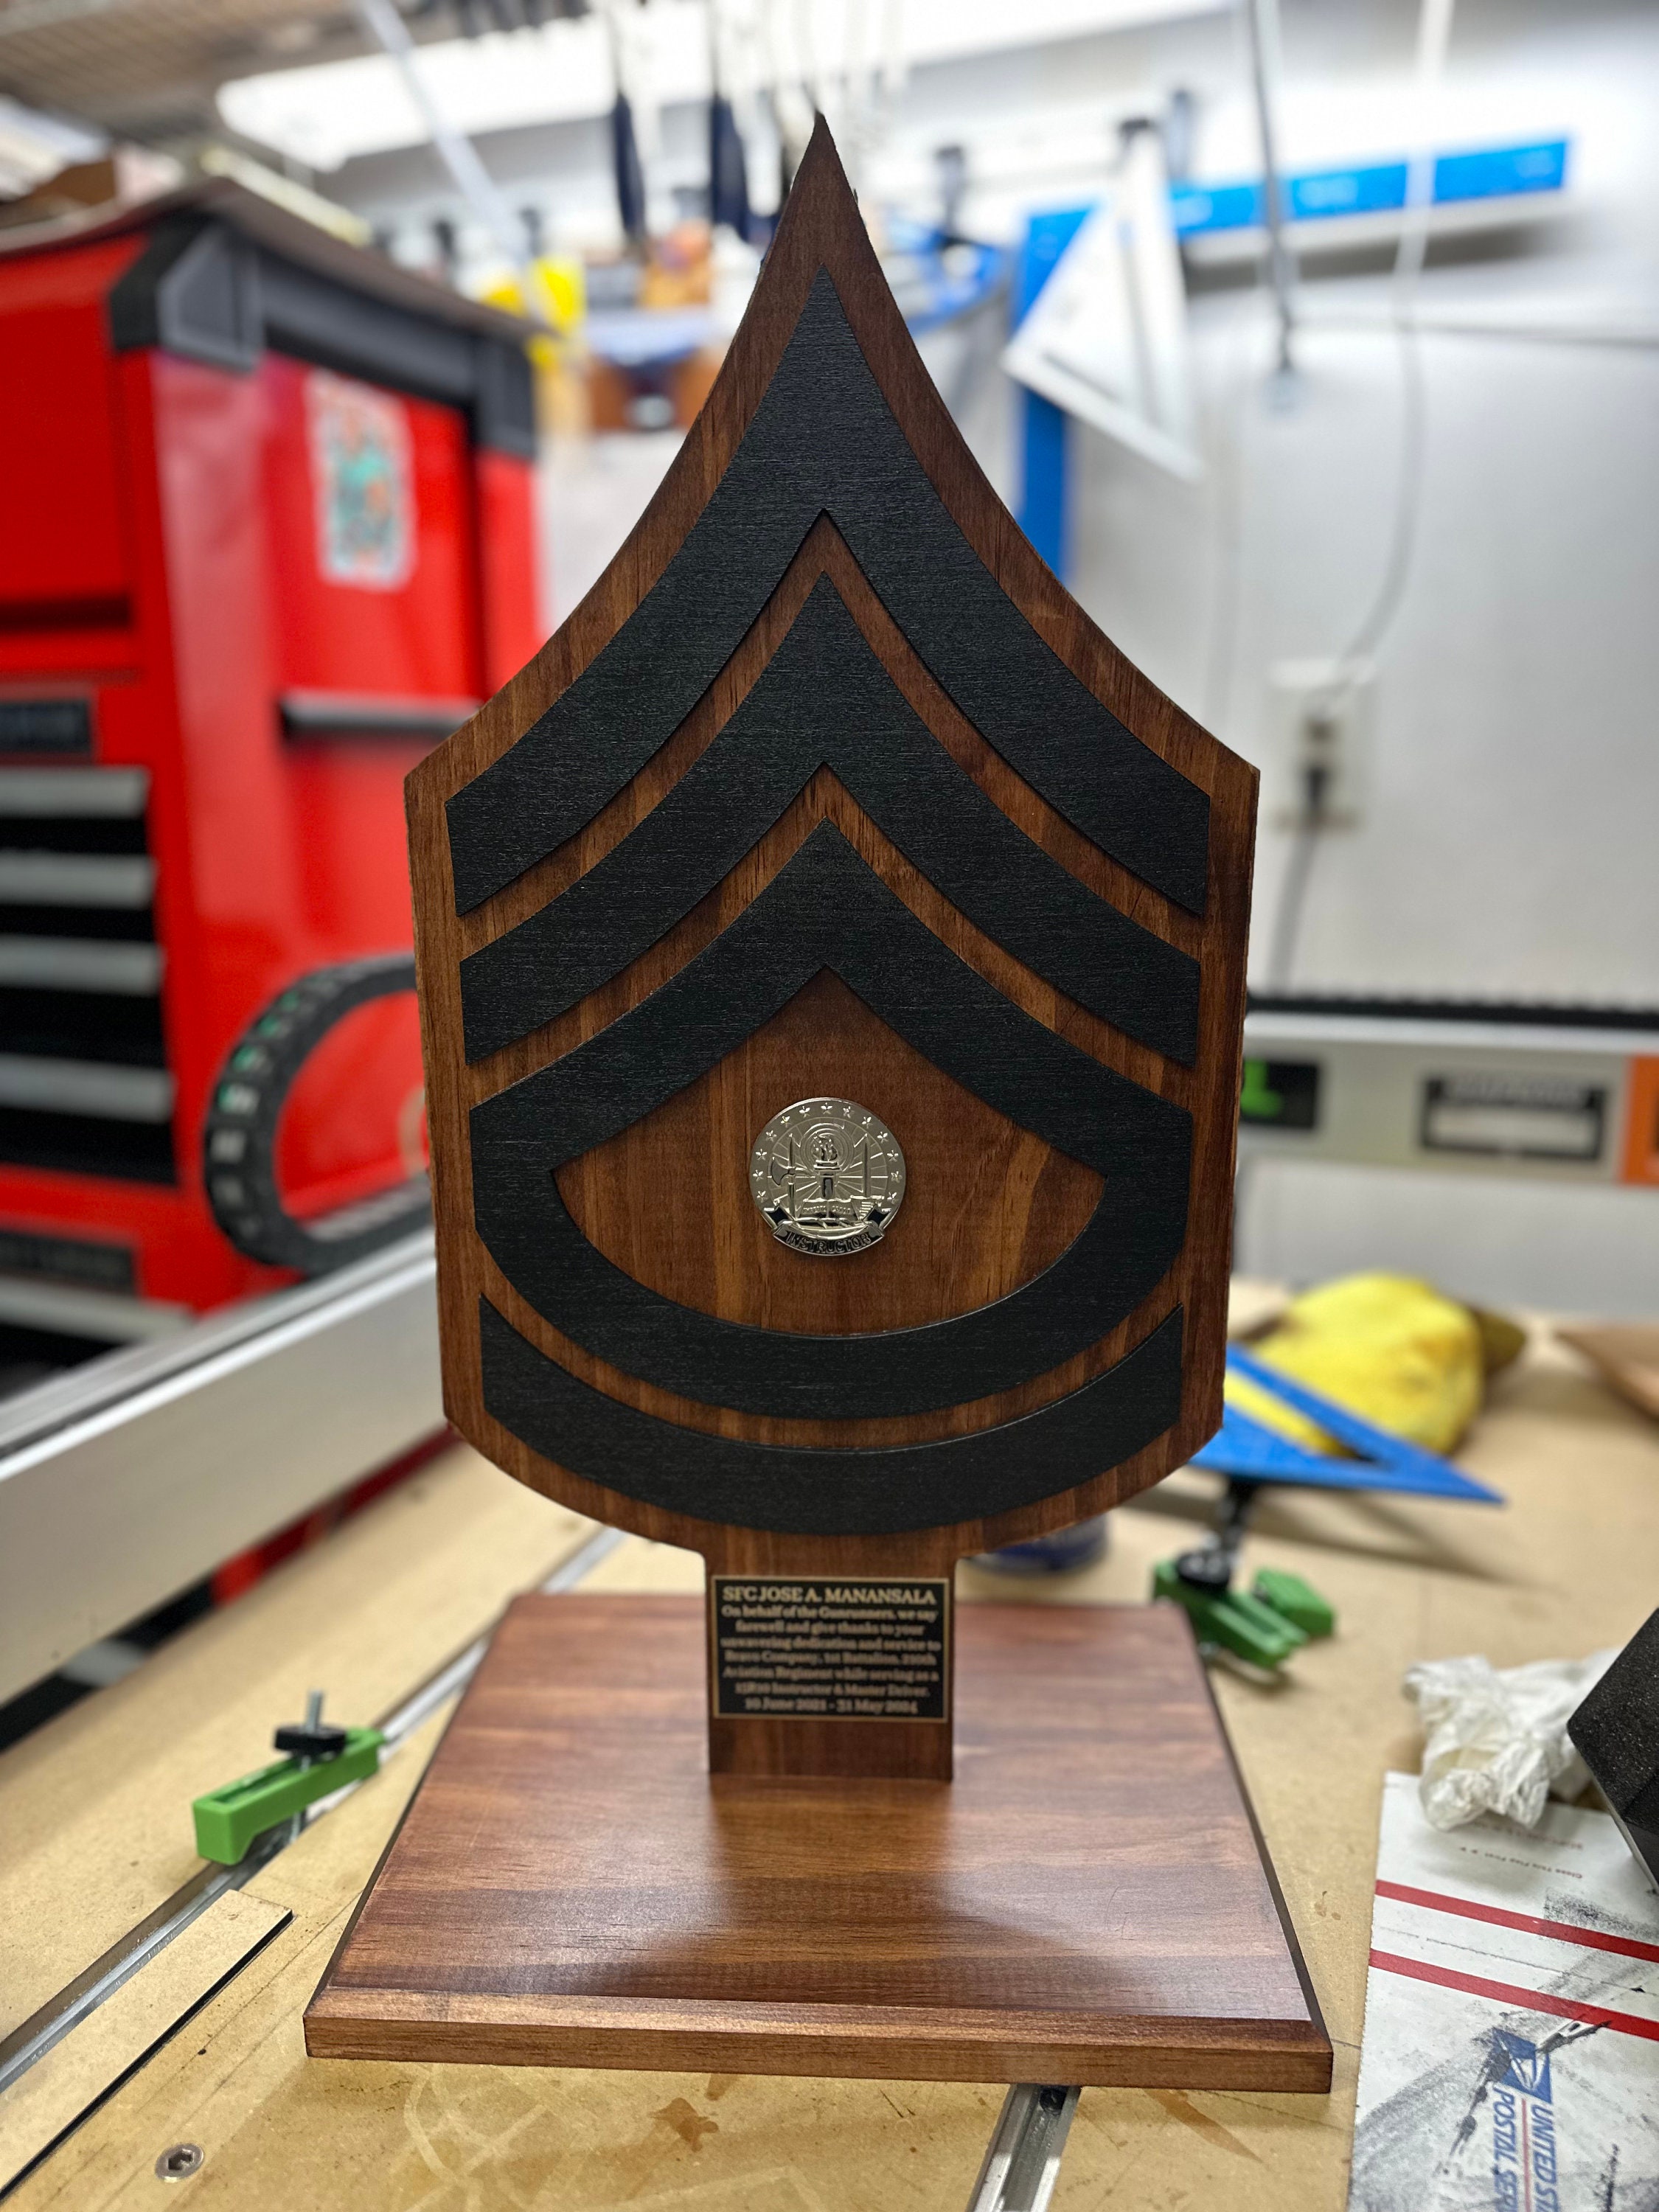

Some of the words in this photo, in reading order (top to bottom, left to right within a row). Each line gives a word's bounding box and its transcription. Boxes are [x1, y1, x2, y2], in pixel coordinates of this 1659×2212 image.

[785, 1231, 872, 1253] INSTRUCTOR
[723, 1586, 758, 1601] SFC
[759, 1587, 804, 1602] JOSE
[804, 1587, 822, 1602] A.
[824, 1587, 936, 1604] MANANSALA
[721, 1604, 742, 1618] On
[742, 1604, 783, 1618] behalf
[783, 1605, 798, 1618] of
[798, 1605, 818, 1618] the
[897, 1610, 916, 1620] we
[917, 1610, 939, 1623] say
[736, 1619, 785, 1632] farewell
[786, 1620, 810, 1633] and
[811, 1621, 836, 1635] give
[838, 1621, 880, 1634] thanks
[880, 1624, 894, 1635] to
[894, 1625, 925, 1638] your
[793, 1635, 857, 1649] dedication
[858, 1638, 882, 1650] and
[883, 1638, 926, 1651] service
[927, 1640, 942, 1652] to
[776, 1666, 833, 1681] Regiment
[1493, 2084, 1518, 2164] POSTAL
[1531, 2104, 1557, 2185] UNITED
